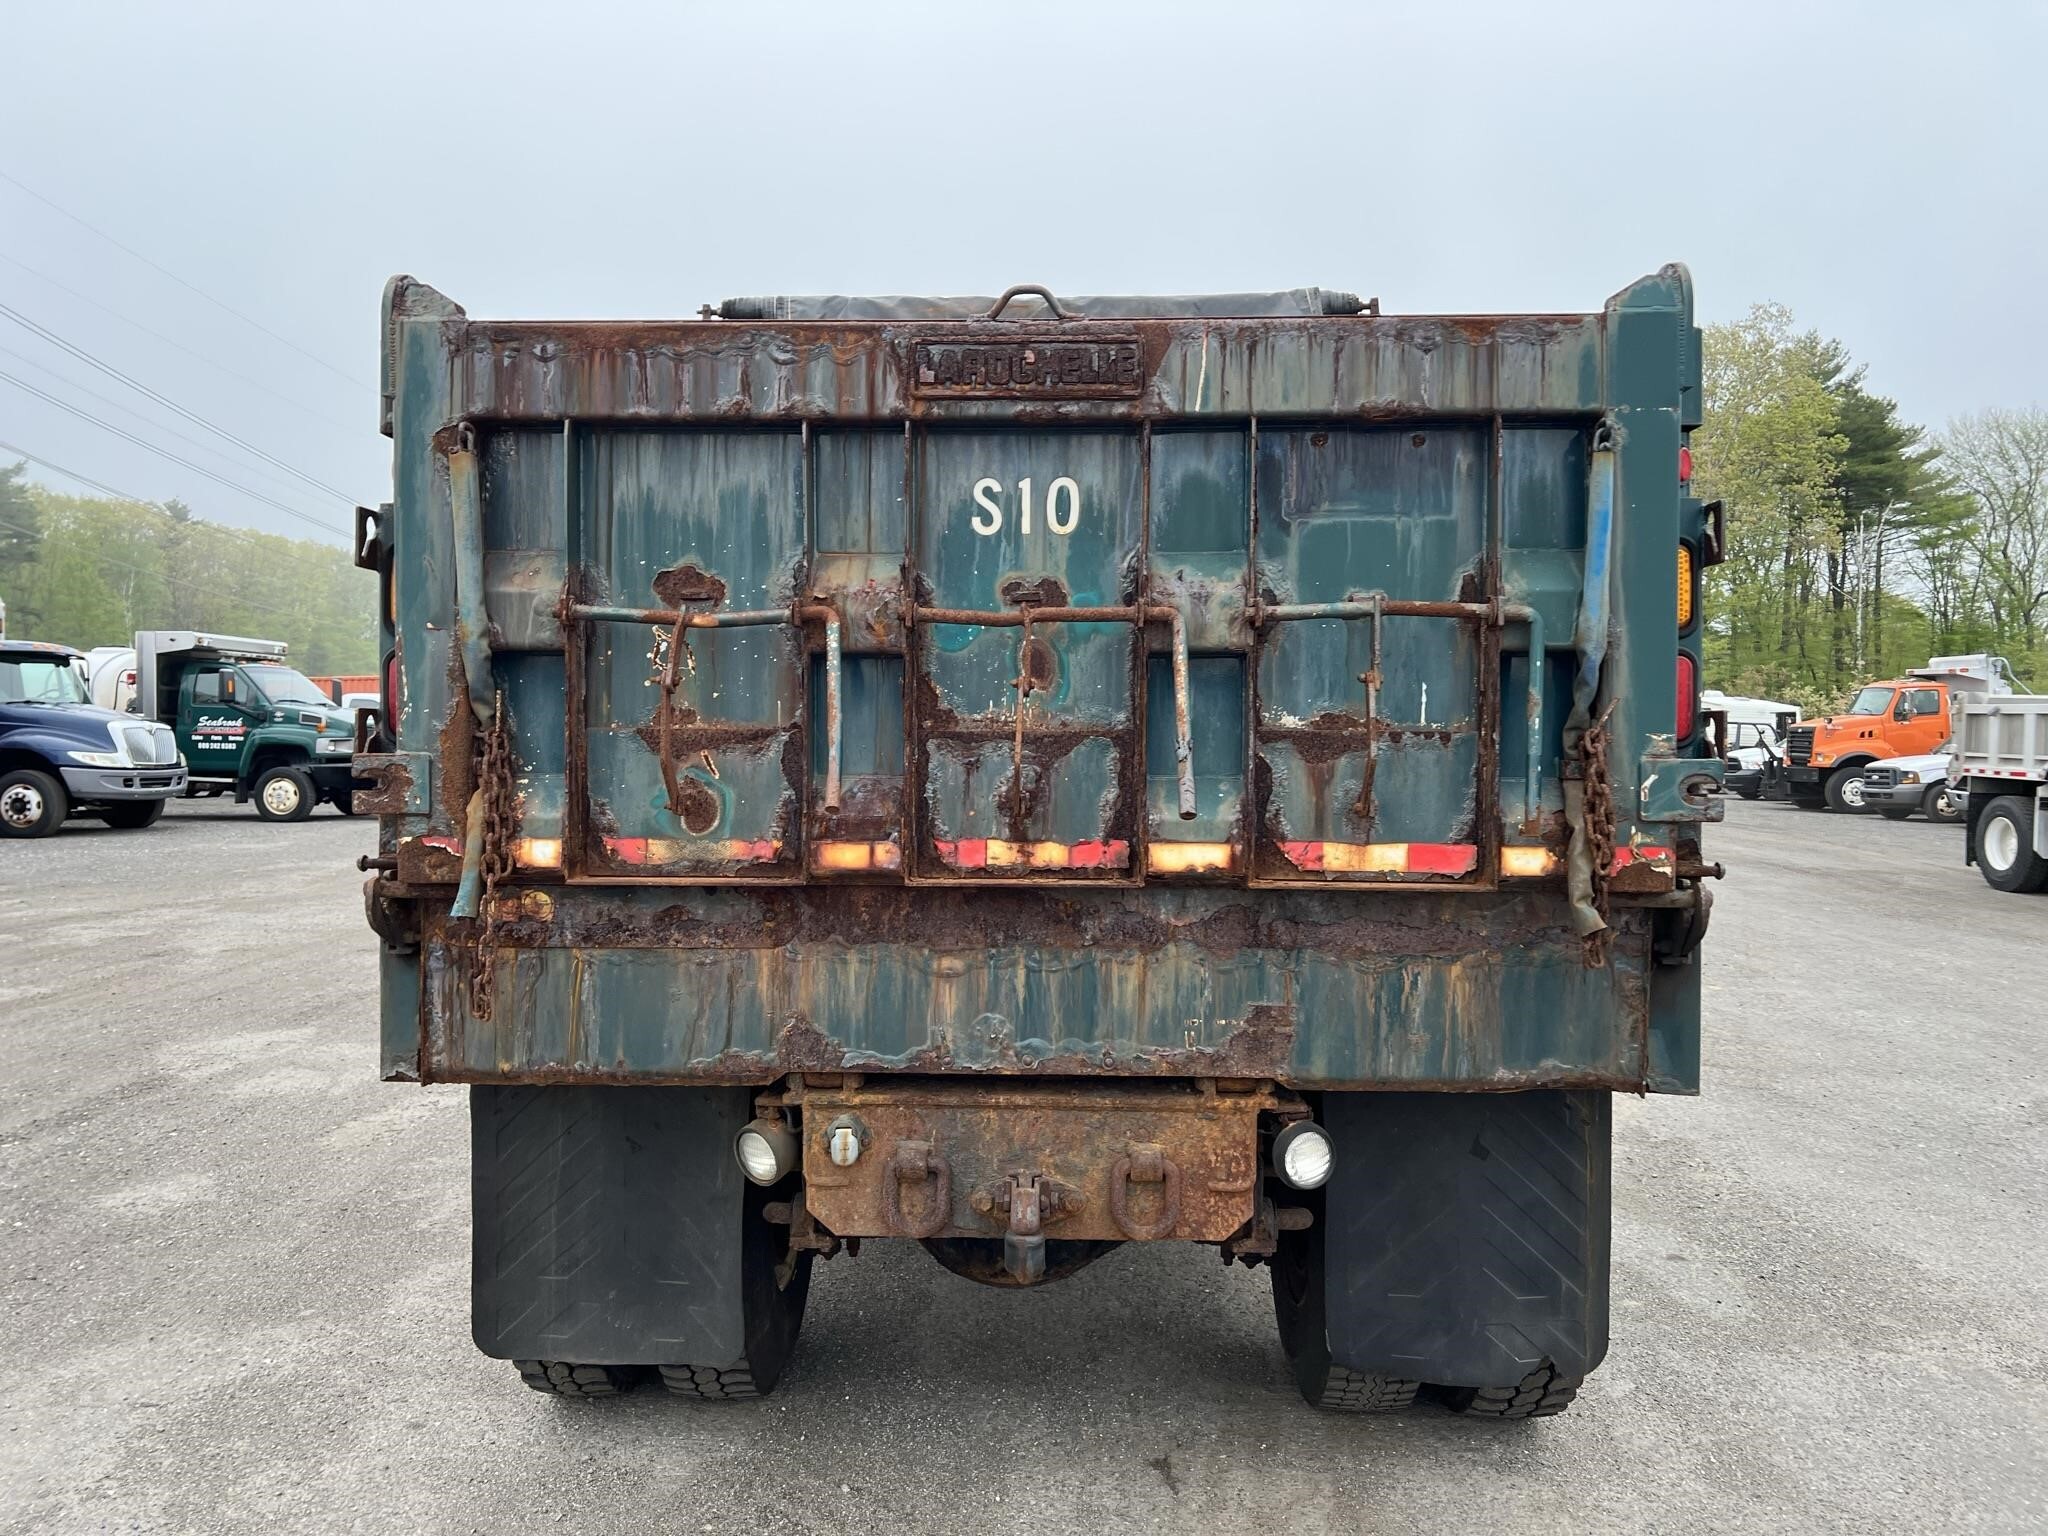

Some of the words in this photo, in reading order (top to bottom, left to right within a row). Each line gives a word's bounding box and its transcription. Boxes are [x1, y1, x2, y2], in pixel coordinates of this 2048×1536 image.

[916, 348, 1140, 385] LAROCHELLE
[971, 476, 1080, 536] S10
[197, 716, 243, 727] Seabrook
